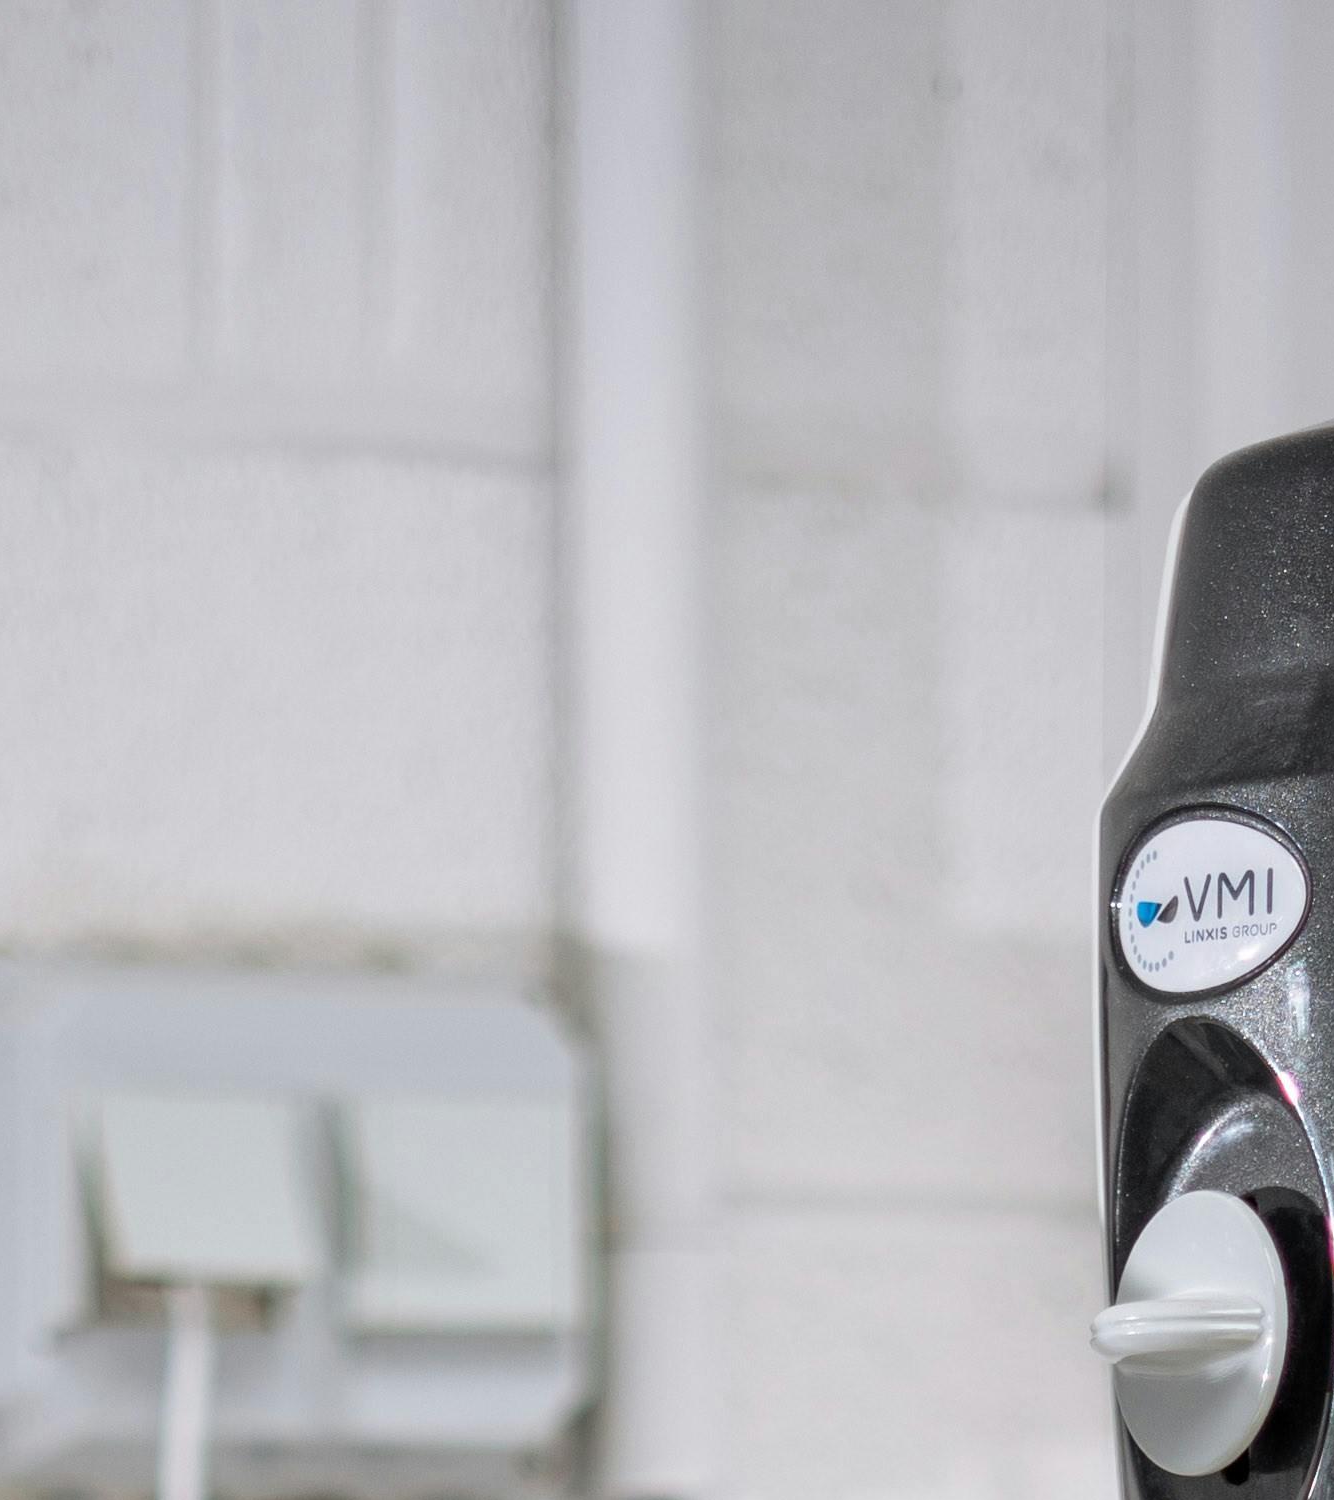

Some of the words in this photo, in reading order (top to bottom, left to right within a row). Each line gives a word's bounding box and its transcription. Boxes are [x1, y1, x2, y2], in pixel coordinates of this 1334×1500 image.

[1183, 867, 1274, 922] VMI
[1183, 926, 1228, 944] LINXIS
[1232, 922, 1278, 939] GROUP
